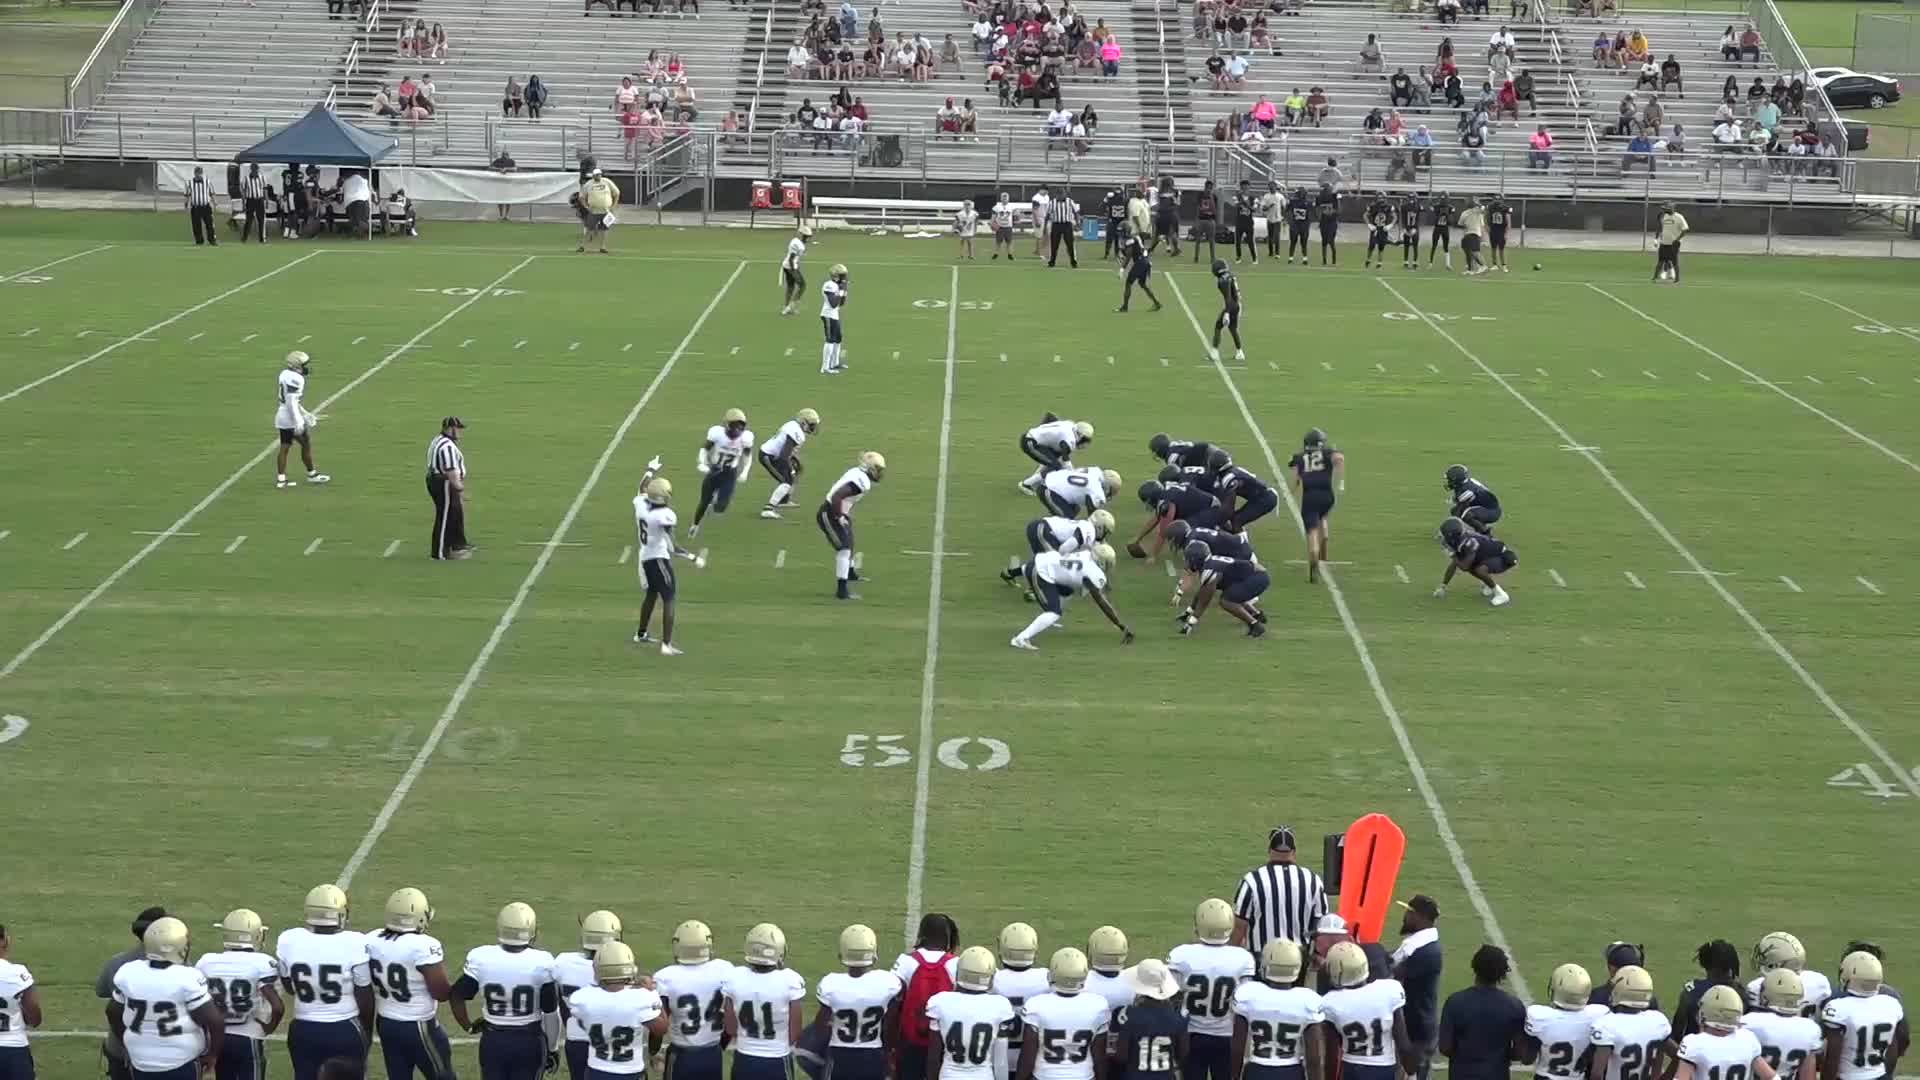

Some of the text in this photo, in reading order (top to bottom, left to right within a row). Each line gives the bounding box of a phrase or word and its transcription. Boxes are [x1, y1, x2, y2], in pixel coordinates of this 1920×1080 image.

[1303, 451, 1326, 472] 12
[840, 734, 1011, 770] 50
[1825, 763, 1920, 797] 4
[290, 963, 343, 1004] 65
[368, 958, 412, 1003] 69
[484, 982, 535, 1016] 60
[1186, 973, 1236, 1018] 20
[126, 1000, 183, 1037] 72
[677, 988, 724, 1036] 34
[738, 1000, 776, 1040] 41
[834, 1006, 884, 1043] 32
[589, 1023, 635, 1062] 42
[945, 1021, 993, 1065] 40
[1043, 1029, 1094, 1064] 53
[1138, 1036, 1172, 1071] 16
[1250, 1020, 1301, 1058] 25
[1343, 1018, 1384, 1056] 21
[1856, 1023, 1893, 1067] 15
